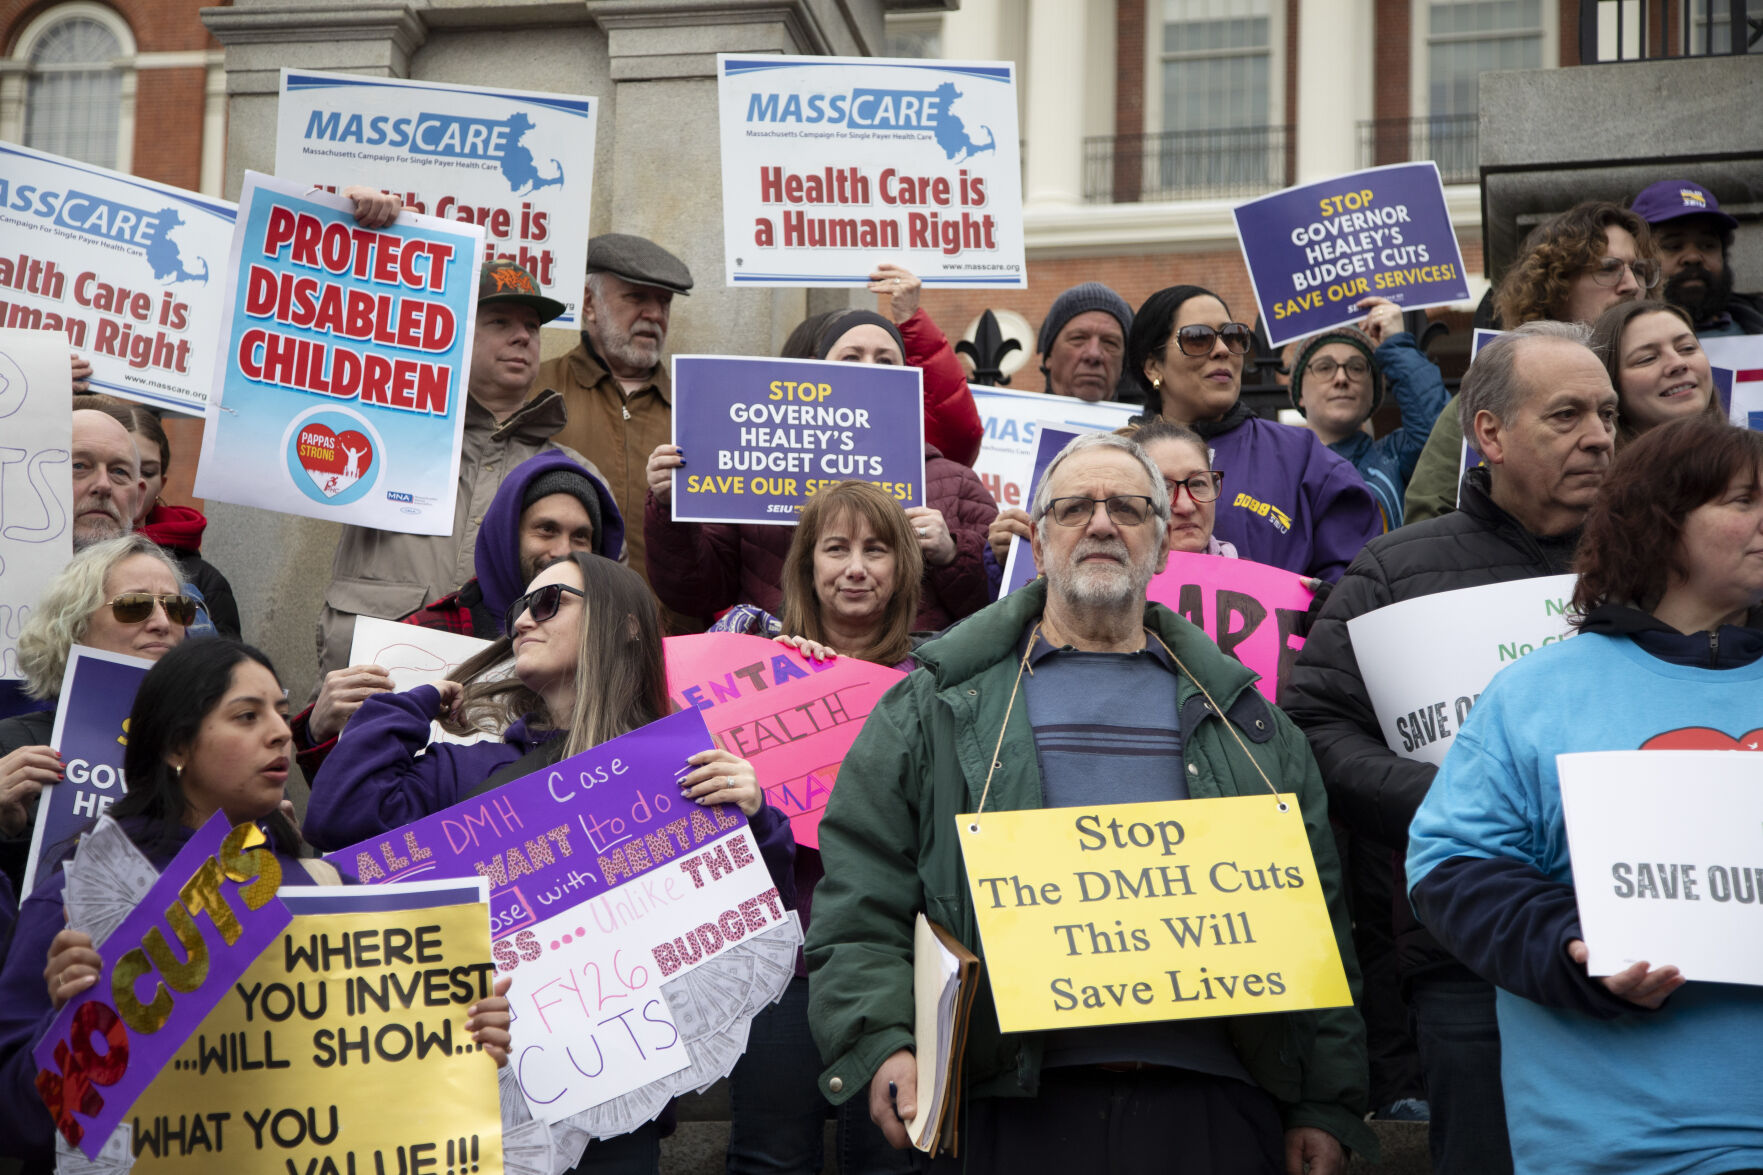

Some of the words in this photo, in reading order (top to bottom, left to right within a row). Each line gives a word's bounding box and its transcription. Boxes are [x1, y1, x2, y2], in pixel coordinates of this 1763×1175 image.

[746, 93, 940, 127] MASSCARE
[304, 110, 511, 157] MASSCARE
[746, 130, 798, 138] Massachusetts
[799, 131, 835, 140] Campaign
[849, 132, 871, 142] Single
[872, 133, 891, 142] Payer
[302, 147, 356, 160] Massachusetts
[357, 151, 395, 164] Campaign
[396, 155, 409, 164] For
[410, 156, 433, 168] Single
[434, 158, 455, 169] Payer
[455, 160, 480, 171] Health
[481, 163, 499, 171] Care
[760, 166, 870, 205] Health
[879, 168, 951, 206] Care
[959, 169, 986, 206] is
[1320, 189, 1374, 217] STOP
[39, 224, 53, 234] For
[53, 228, 77, 241] Single
[78, 235, 100, 247] Payer
[100, 240, 125, 253] Health
[126, 247, 143, 257] Care
[520, 202, 548, 241] is
[754, 218, 774, 248] a
[783, 210, 900, 248] Human
[908, 211, 996, 255] Right
[1291, 205, 1411, 246] GOVERNOR
[264, 205, 453, 292] PROTECT
[942, 263, 1021, 272] www.masscare.org
[1292, 252, 1375, 292] BUDGET
[1380, 244, 1430, 267] CUTS
[1305, 227, 1403, 265] HEALEY'S
[74, 271, 151, 321] Care
[158, 291, 190, 332] is
[246, 265, 456, 352] DISABLED
[1273, 291, 1324, 320] SAVE
[1328, 278, 1371, 302] OUR
[1374, 263, 1457, 290] SERVICES!
[94, 317, 191, 374] Right
[124, 373, 207, 401] www.masscare.org
[239, 330, 450, 415] CHILDREN
[769, 381, 832, 403] STOP
[729, 403, 871, 429] GOVERNOR
[740, 427, 854, 450] HEALEY'S
[300, 445, 334, 461] STRONG
[301, 431, 335, 449] PAPPAS
[718, 450, 814, 473] BUDGET
[820, 454, 883, 475] CUTS
[387, 491, 411, 502] MNA
[687, 475, 745, 494] SAVE
[751, 477, 798, 496] OUR
[766, 504, 793, 514] SEIU
[674, 654, 835, 714] ENTAL
[718, 693, 850, 757] EALTH
[1396, 701, 1451, 754] SAVE
[355, 831, 432, 884] ALL
[441, 796, 524, 855] DMH
[548, 757, 629, 802] Case
[474, 823, 574, 889] WANT
[589, 813, 626, 844] to
[632, 790, 672, 824] do
[1075, 814, 1185, 856] Stop
[537, 869, 597, 905] with
[597, 802, 740, 888] MENTAL
[680, 833, 756, 890] THE
[979, 875, 1062, 909] The
[1073, 865, 1197, 902] DMH
[1208, 860, 1305, 893] Cuts
[1612, 862, 1700, 901] SAVE
[111, 820, 283, 1035] CUTS
[285, 925, 443, 973] WHERE
[1054, 920, 1150, 956] This
[1160, 911, 1257, 949] Will
[531, 949, 648, 1034] FY26
[651, 887, 782, 977] BUDGET
[235, 980, 327, 1022] YOU
[345, 962, 496, 1016] INVEST
[1050, 977, 1154, 1012] Save
[1164, 967, 1287, 1003] Lives
[518, 999, 678, 1104] CUTS
[132, 1112, 231, 1158] WHAT
[244, 1104, 339, 1150] YOU
